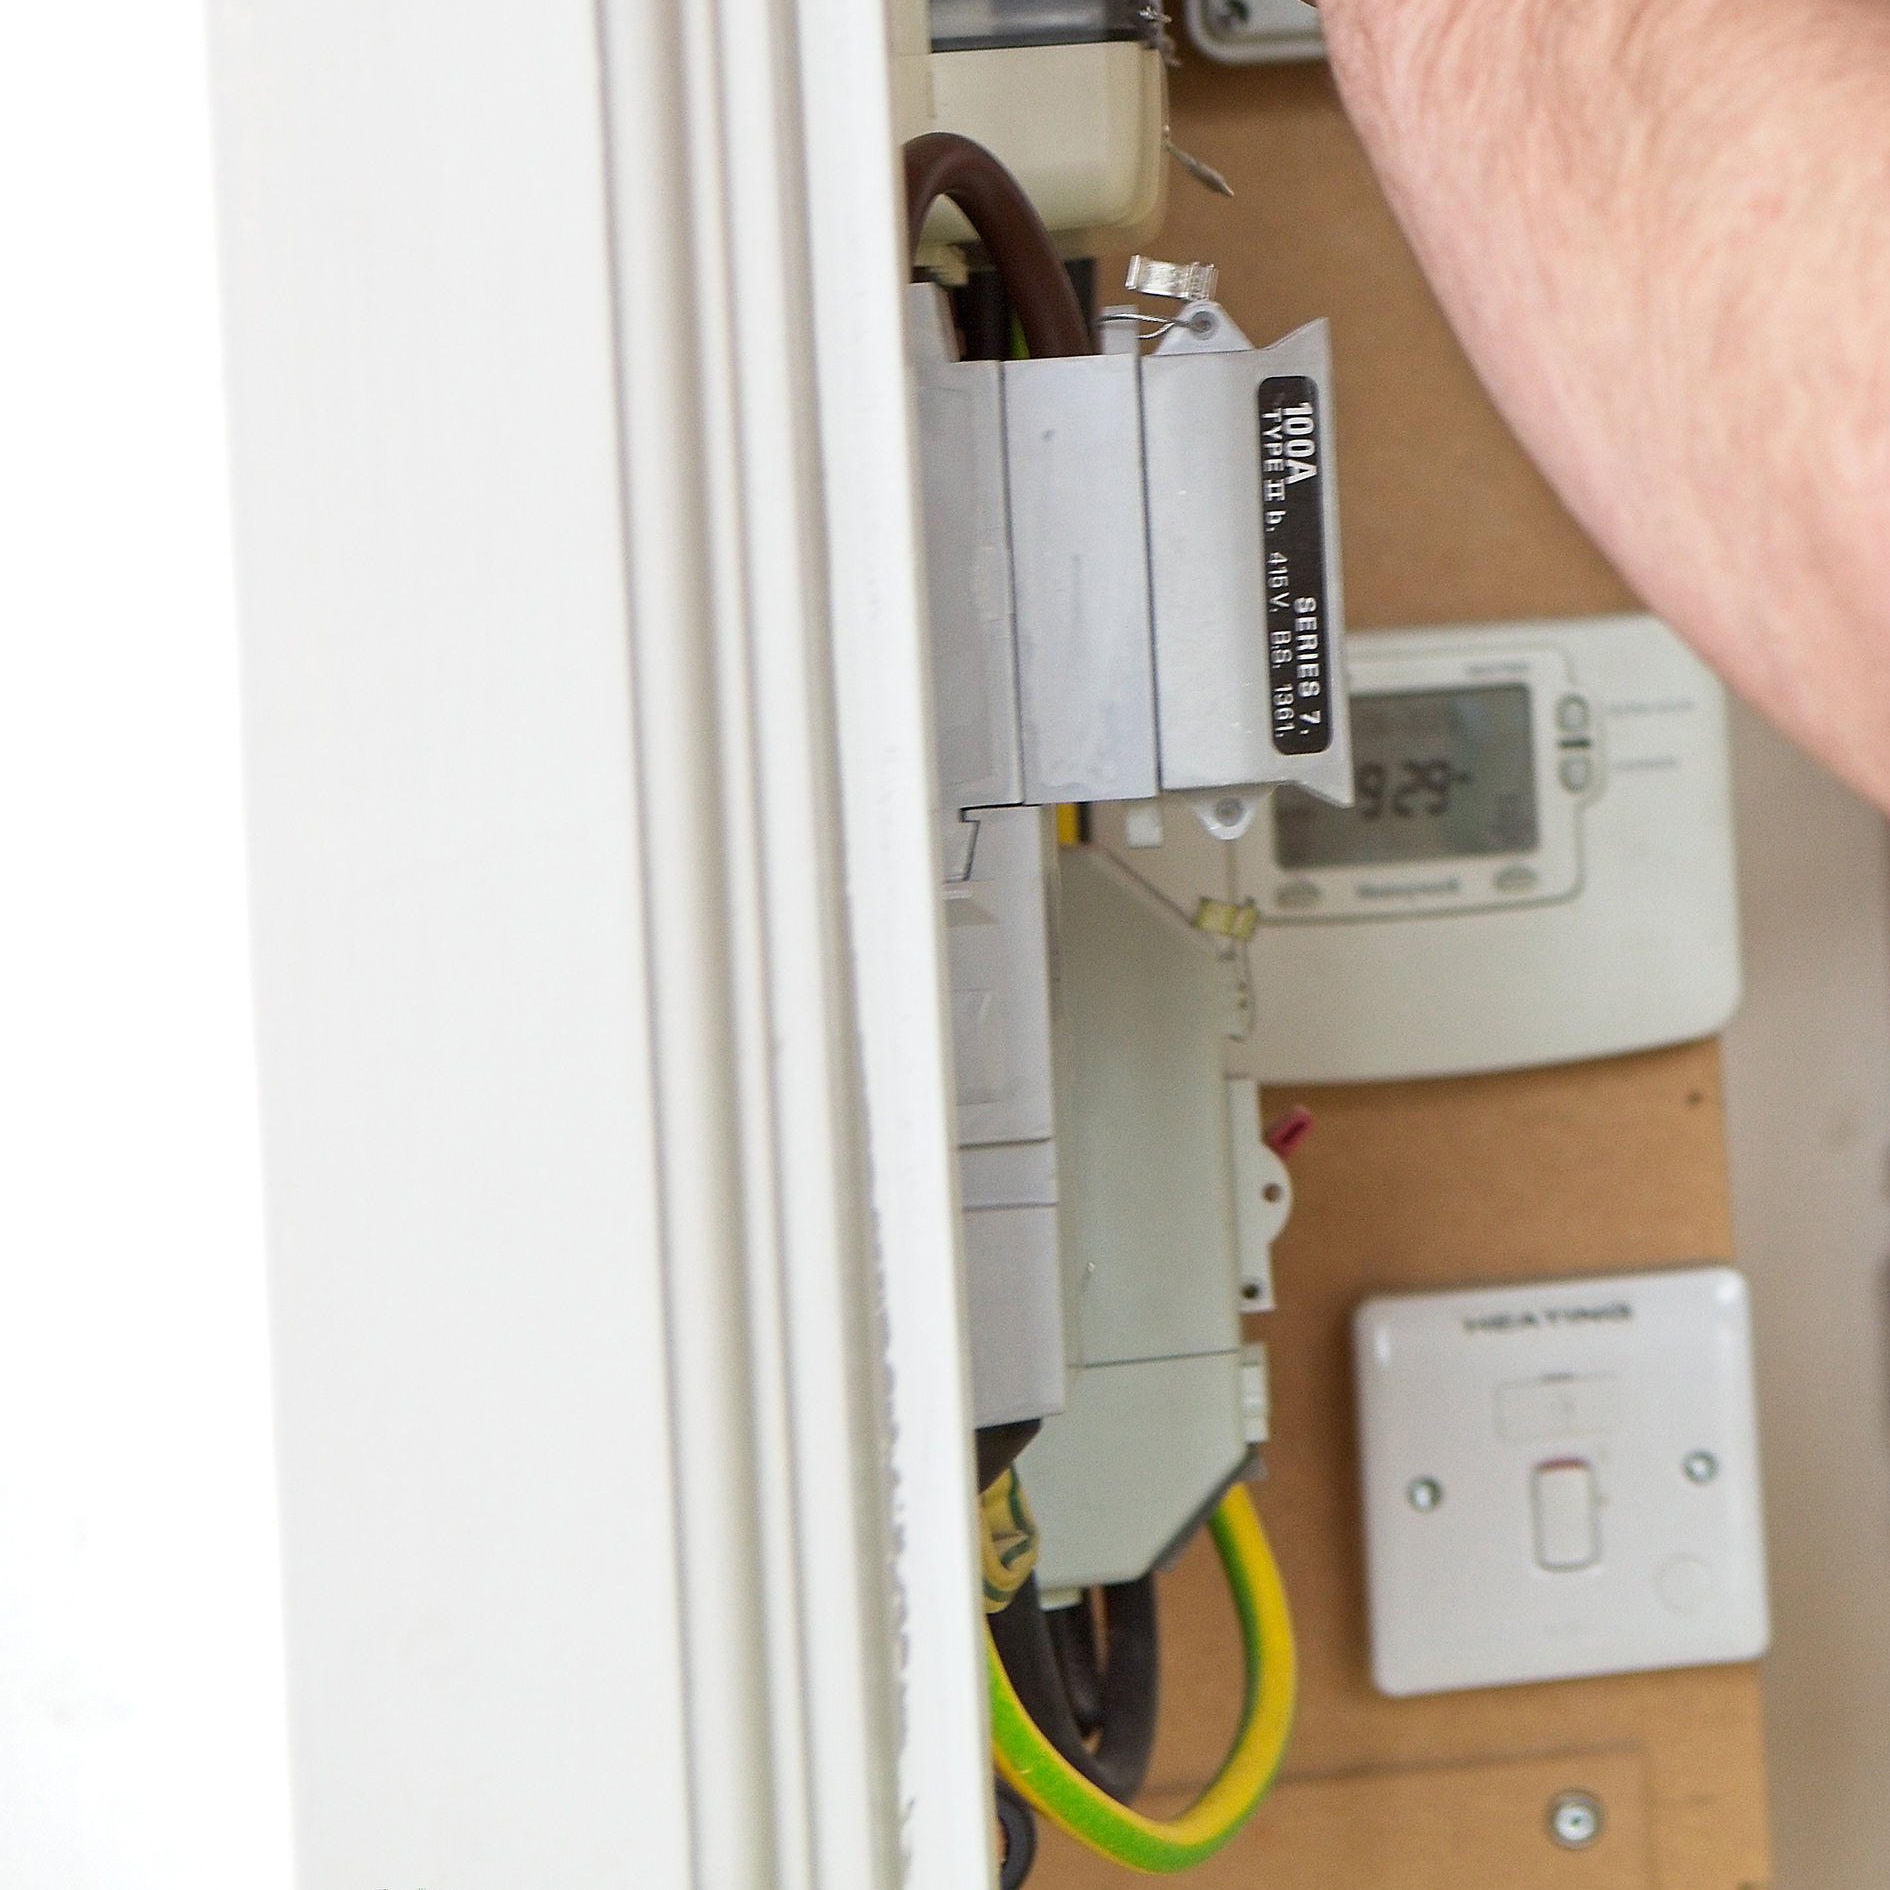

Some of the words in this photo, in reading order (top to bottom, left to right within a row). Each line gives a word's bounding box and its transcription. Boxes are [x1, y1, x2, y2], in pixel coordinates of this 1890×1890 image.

[1262, 407, 1284, 473] TYPE
[1283, 401, 1318, 486] 100A
[1294, 596, 1321, 699] SERIES
